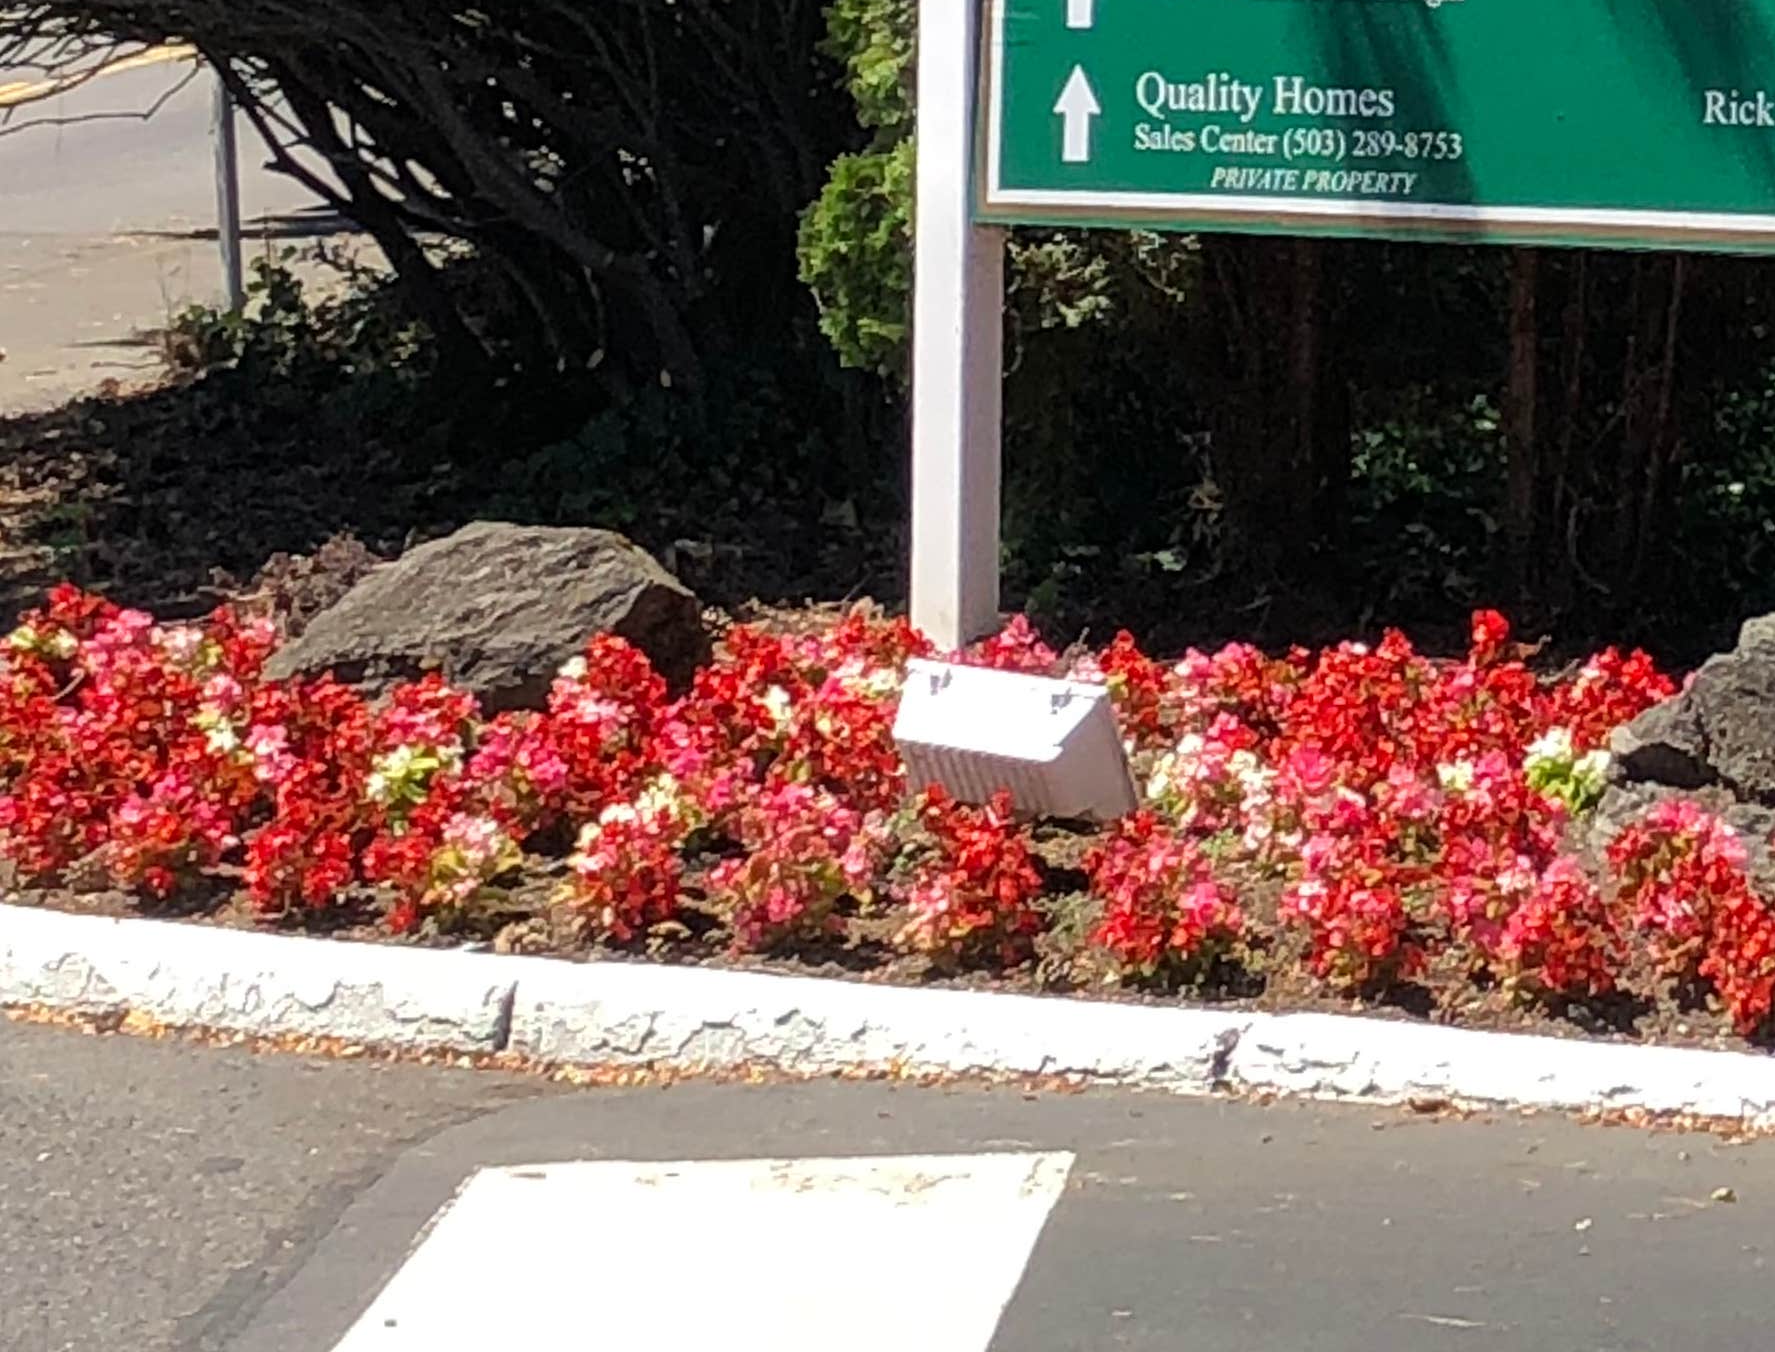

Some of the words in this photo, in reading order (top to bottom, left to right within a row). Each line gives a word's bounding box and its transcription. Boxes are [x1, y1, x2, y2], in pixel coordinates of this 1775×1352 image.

[1136, 72, 1262, 121] Quality
[1273, 75, 1394, 117] Homes
[1134, 124, 1194, 152] Sales
[1201, 125, 1278, 155] Center
[1282, 126, 1346, 159] (503)
[1352, 130, 1462, 160] 289-8753
[1210, 168, 1298, 192] PRIVATE
[1302, 168, 1416, 195] PROPERTY
